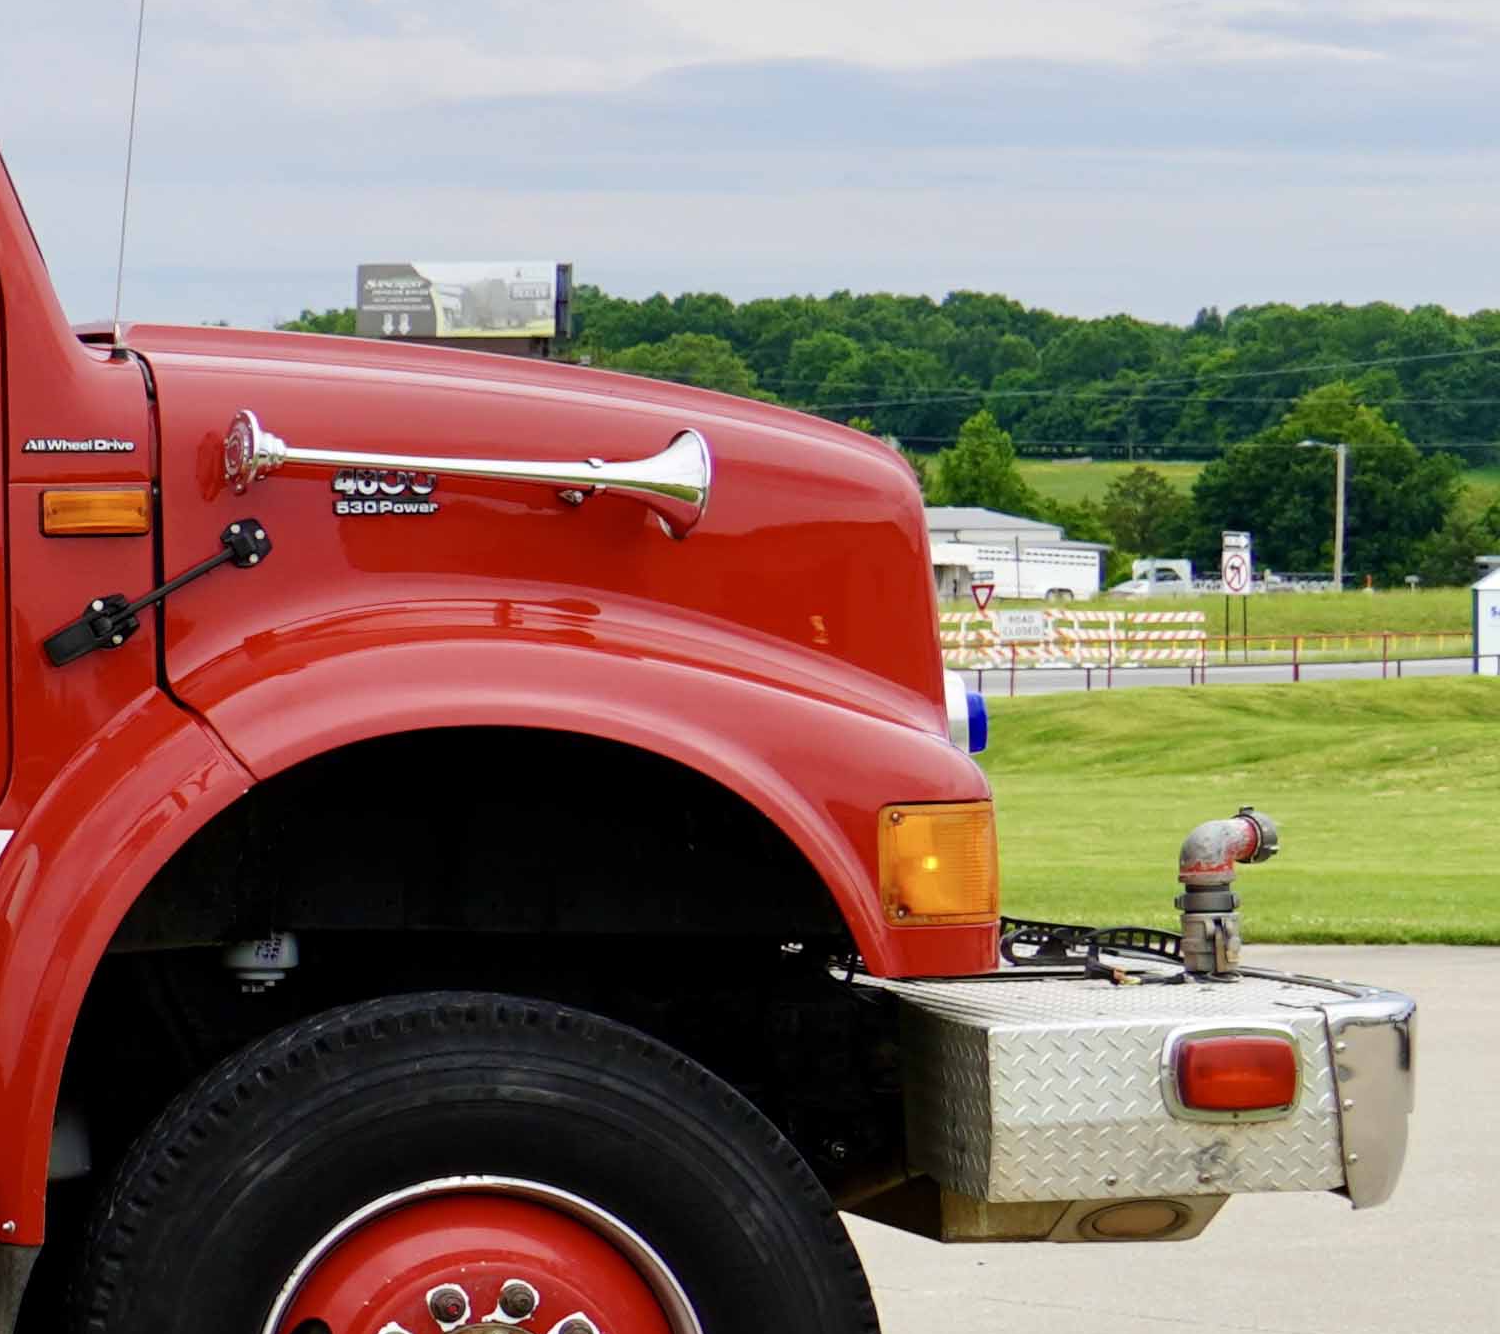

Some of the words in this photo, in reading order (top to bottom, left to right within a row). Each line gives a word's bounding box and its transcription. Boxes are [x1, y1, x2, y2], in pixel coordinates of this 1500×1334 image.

[24, 439, 45, 451] All
[46, 439, 93, 451] Wheel
[94, 439, 135, 451] Drive
[336, 500, 377, 515] 530
[379, 500, 439, 514] Power
